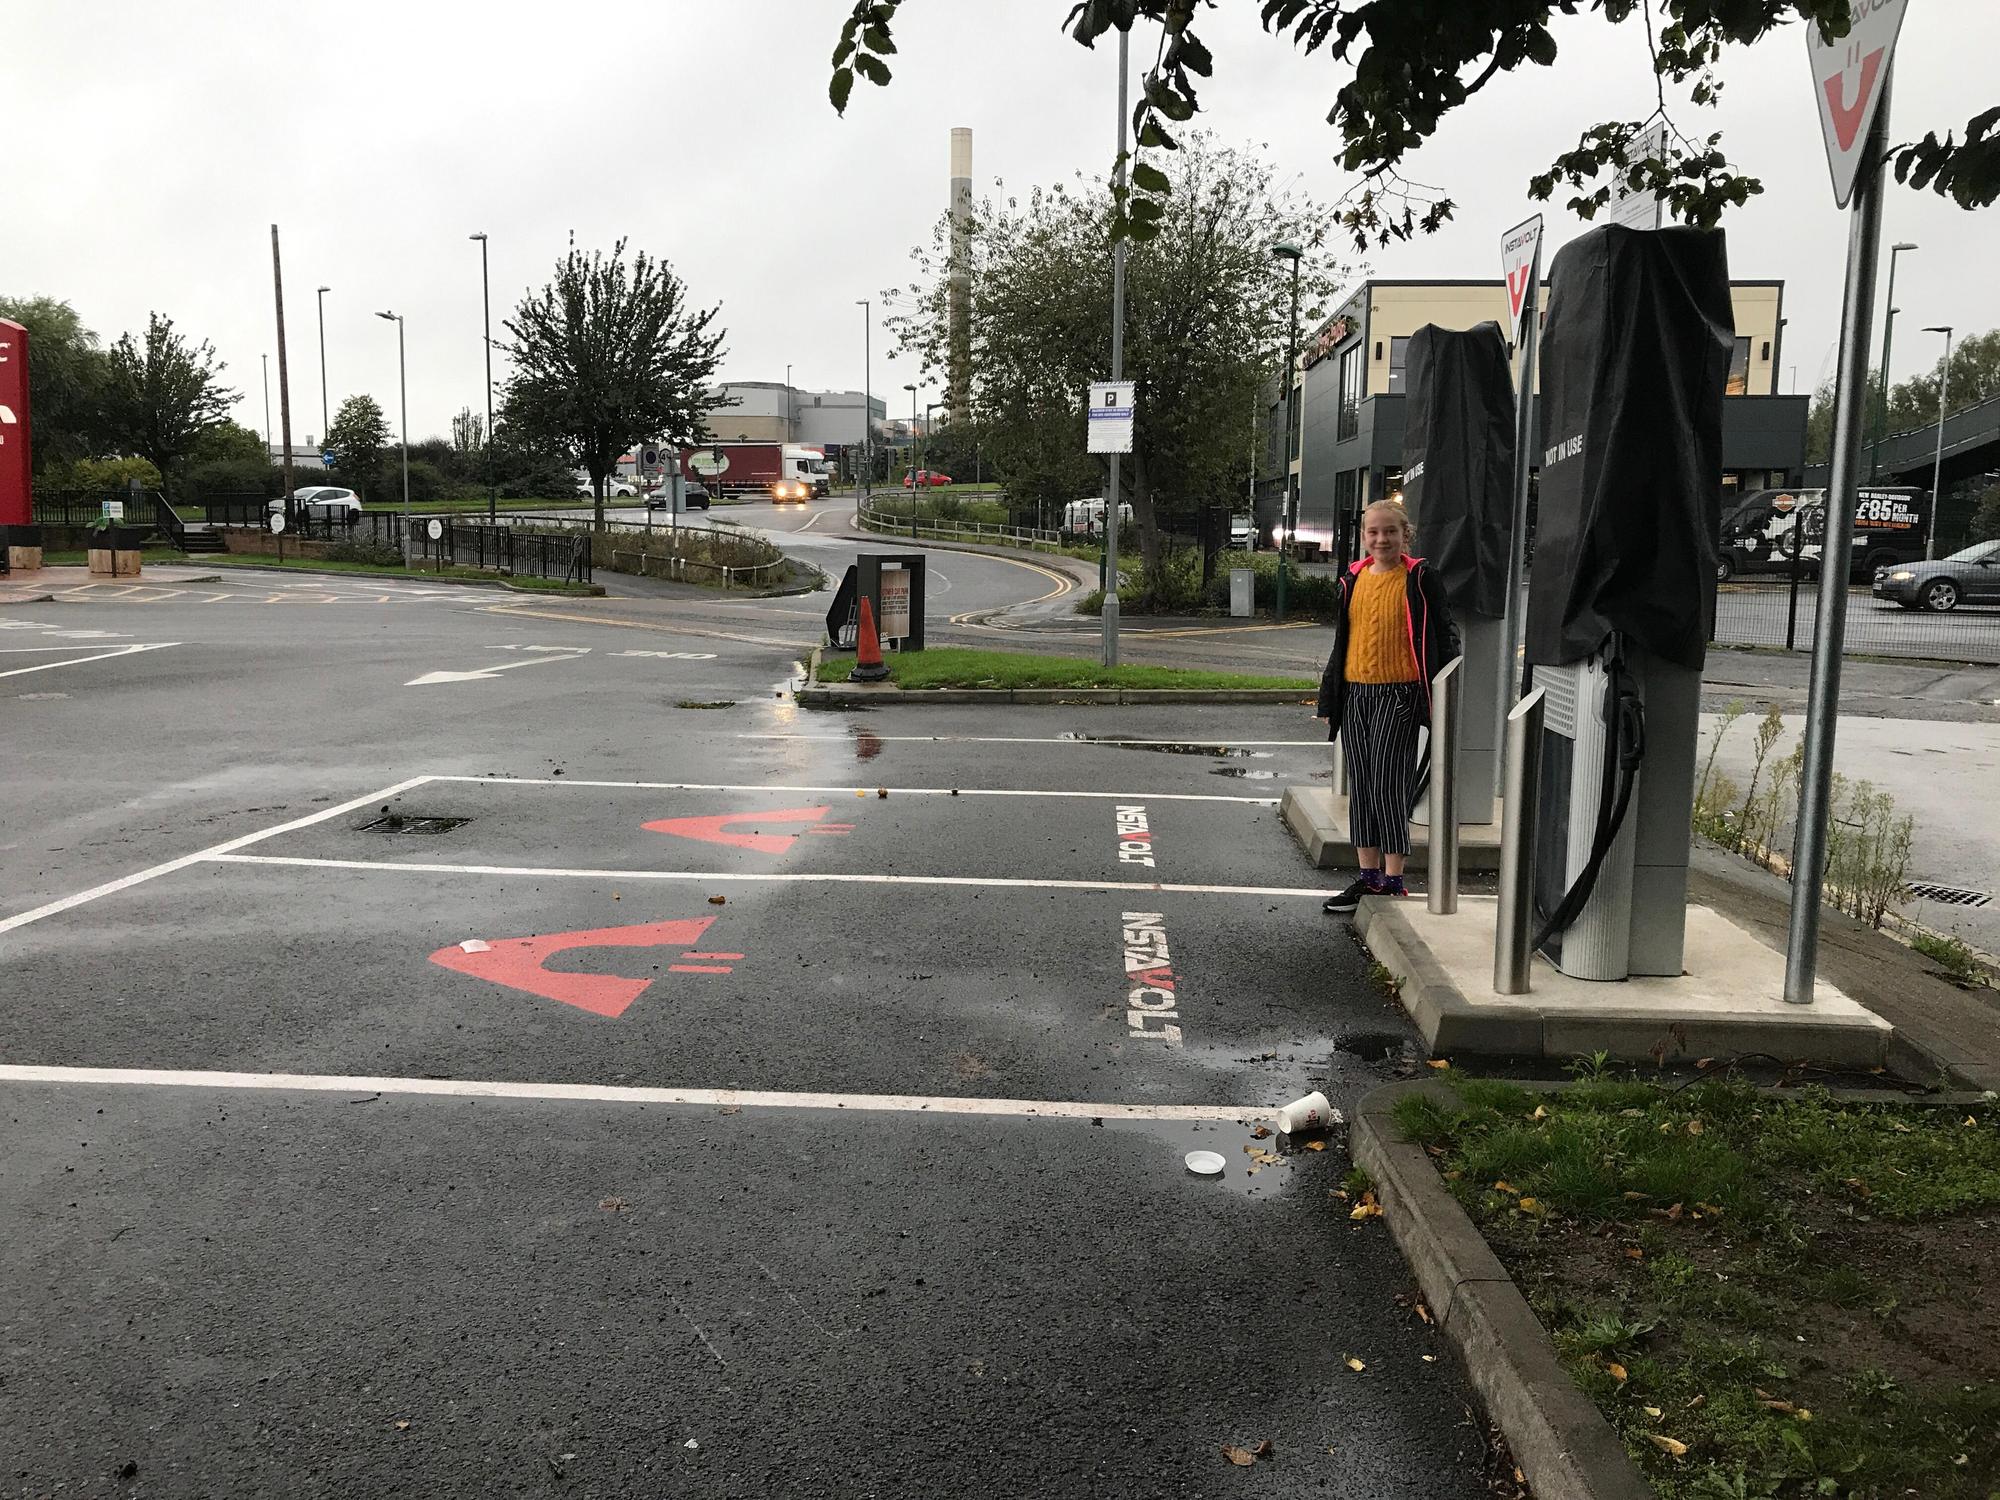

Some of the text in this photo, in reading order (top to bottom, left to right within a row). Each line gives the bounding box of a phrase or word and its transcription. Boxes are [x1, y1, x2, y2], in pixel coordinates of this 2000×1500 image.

[1107, 394, 1114, 405] P
[1545, 434, 1583, 468] NOT IN USE
[1855, 499, 1908, 521] £85 PER
[1892, 512, 1919, 524] MONTH
